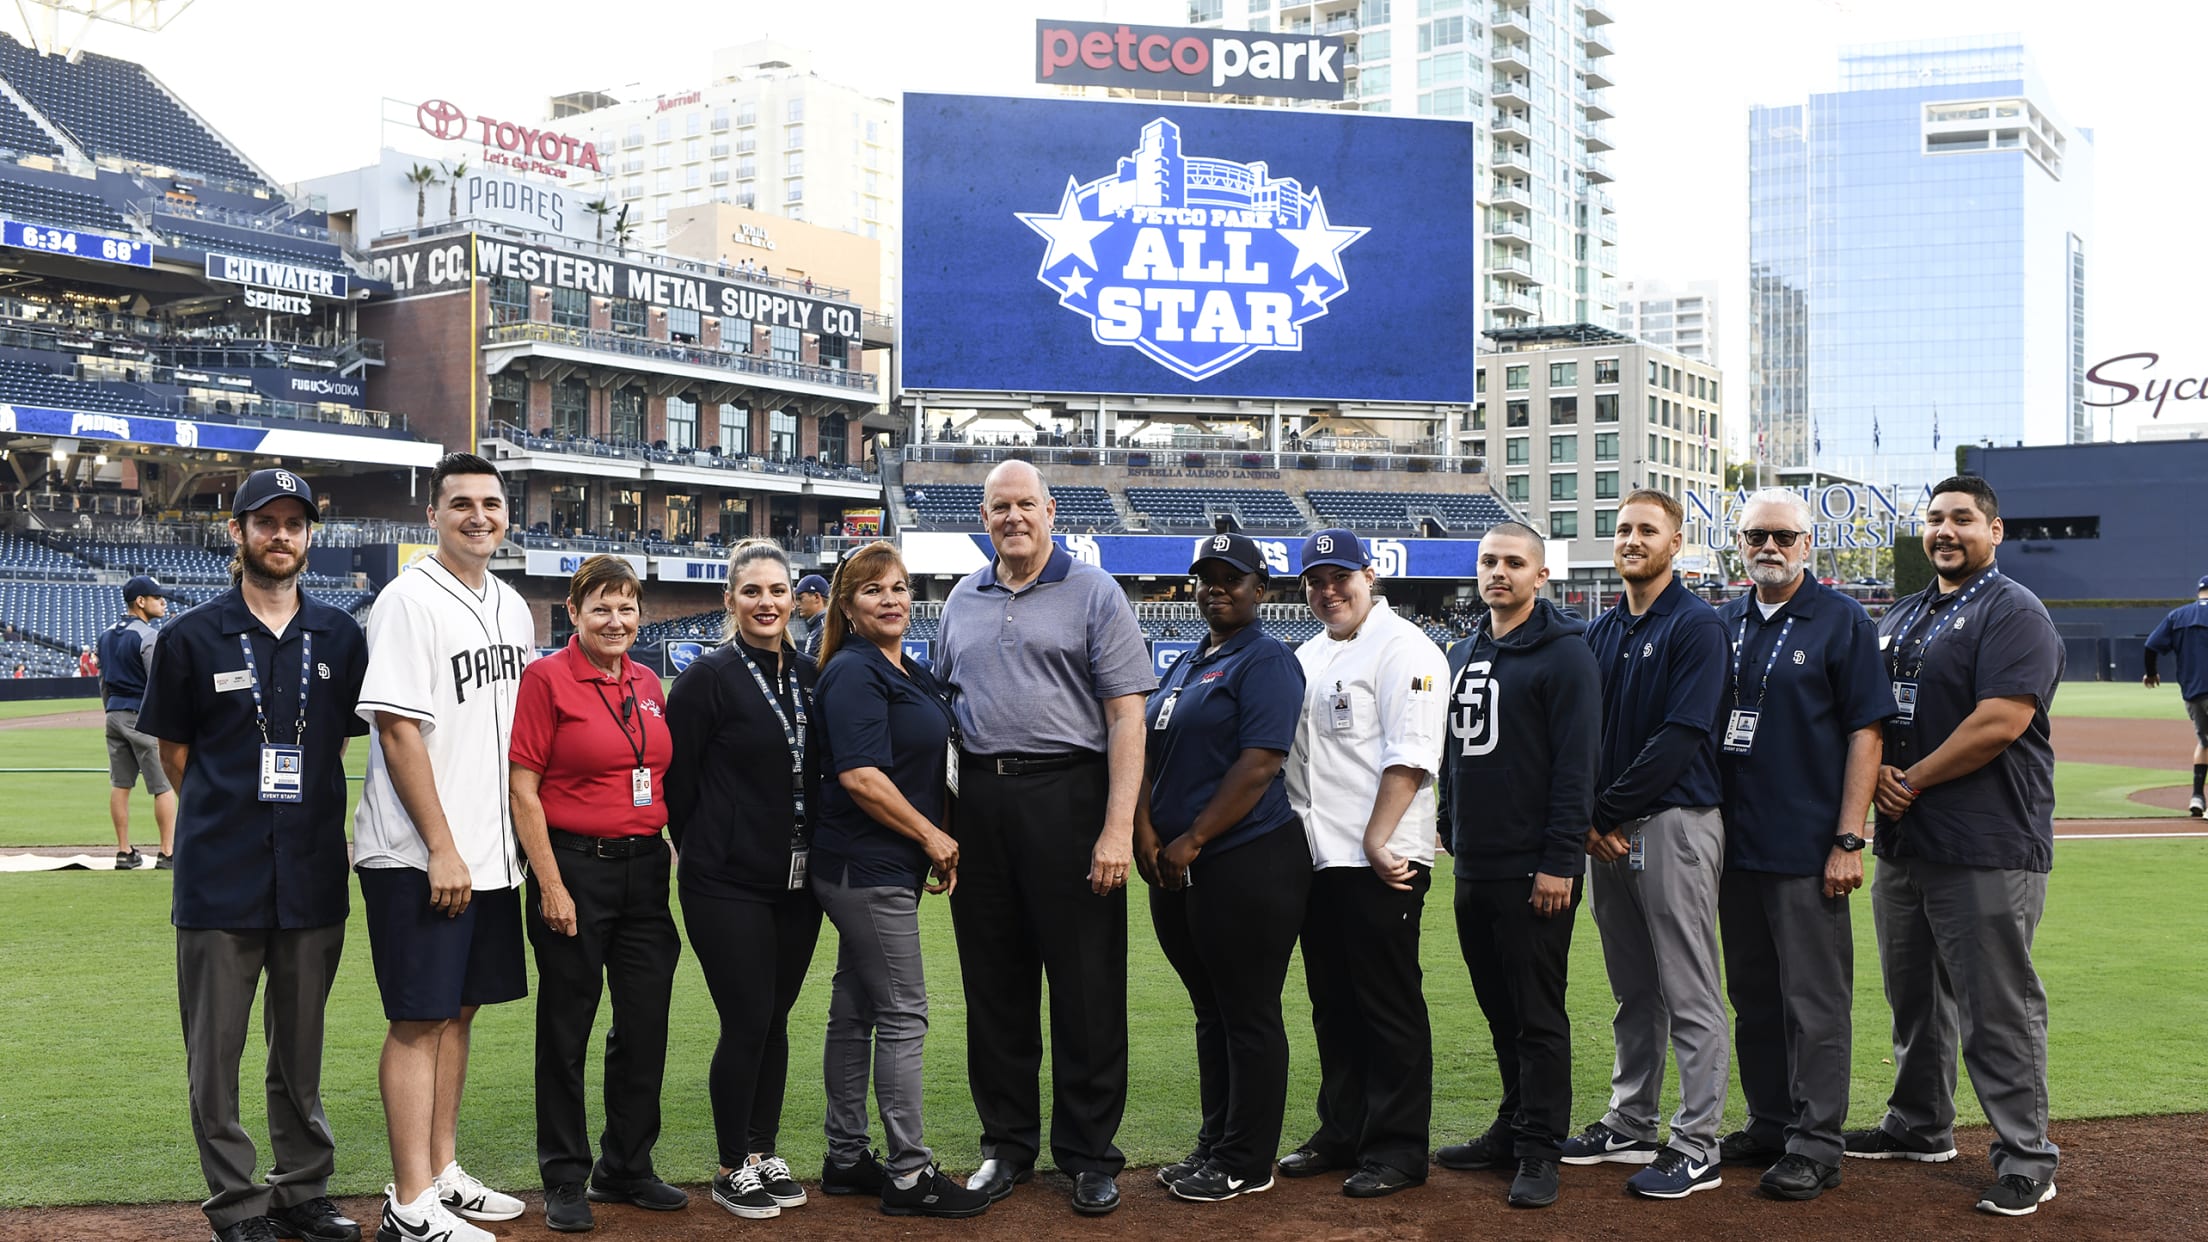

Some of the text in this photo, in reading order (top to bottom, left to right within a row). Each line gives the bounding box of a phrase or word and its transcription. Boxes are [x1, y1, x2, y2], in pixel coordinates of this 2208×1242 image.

[477, 115, 601, 172] TOYOTA
[483, 149, 567, 179] Let's Go Places
[469, 176, 563, 233] PADRES
[1132, 206, 1273, 229] PETCO PARK
[23, 226, 77, 253] 6:34
[1122, 227, 1269, 284] ALL
[224, 257, 333, 295] CUTWATER
[476, 239, 859, 339] WESTERN METAL SUPPLY CO.
[244, 289, 312, 316] SPIRITS
[1097, 286, 1297, 345] STAR
[291, 378, 359, 397] FUGU VODKA
[1127, 468, 1280, 480] ESTRELLA JALISCO LANDING
[687, 562, 704, 579] HIT
[706, 563, 717, 579] IT
[450, 644, 528, 704] PADRE
